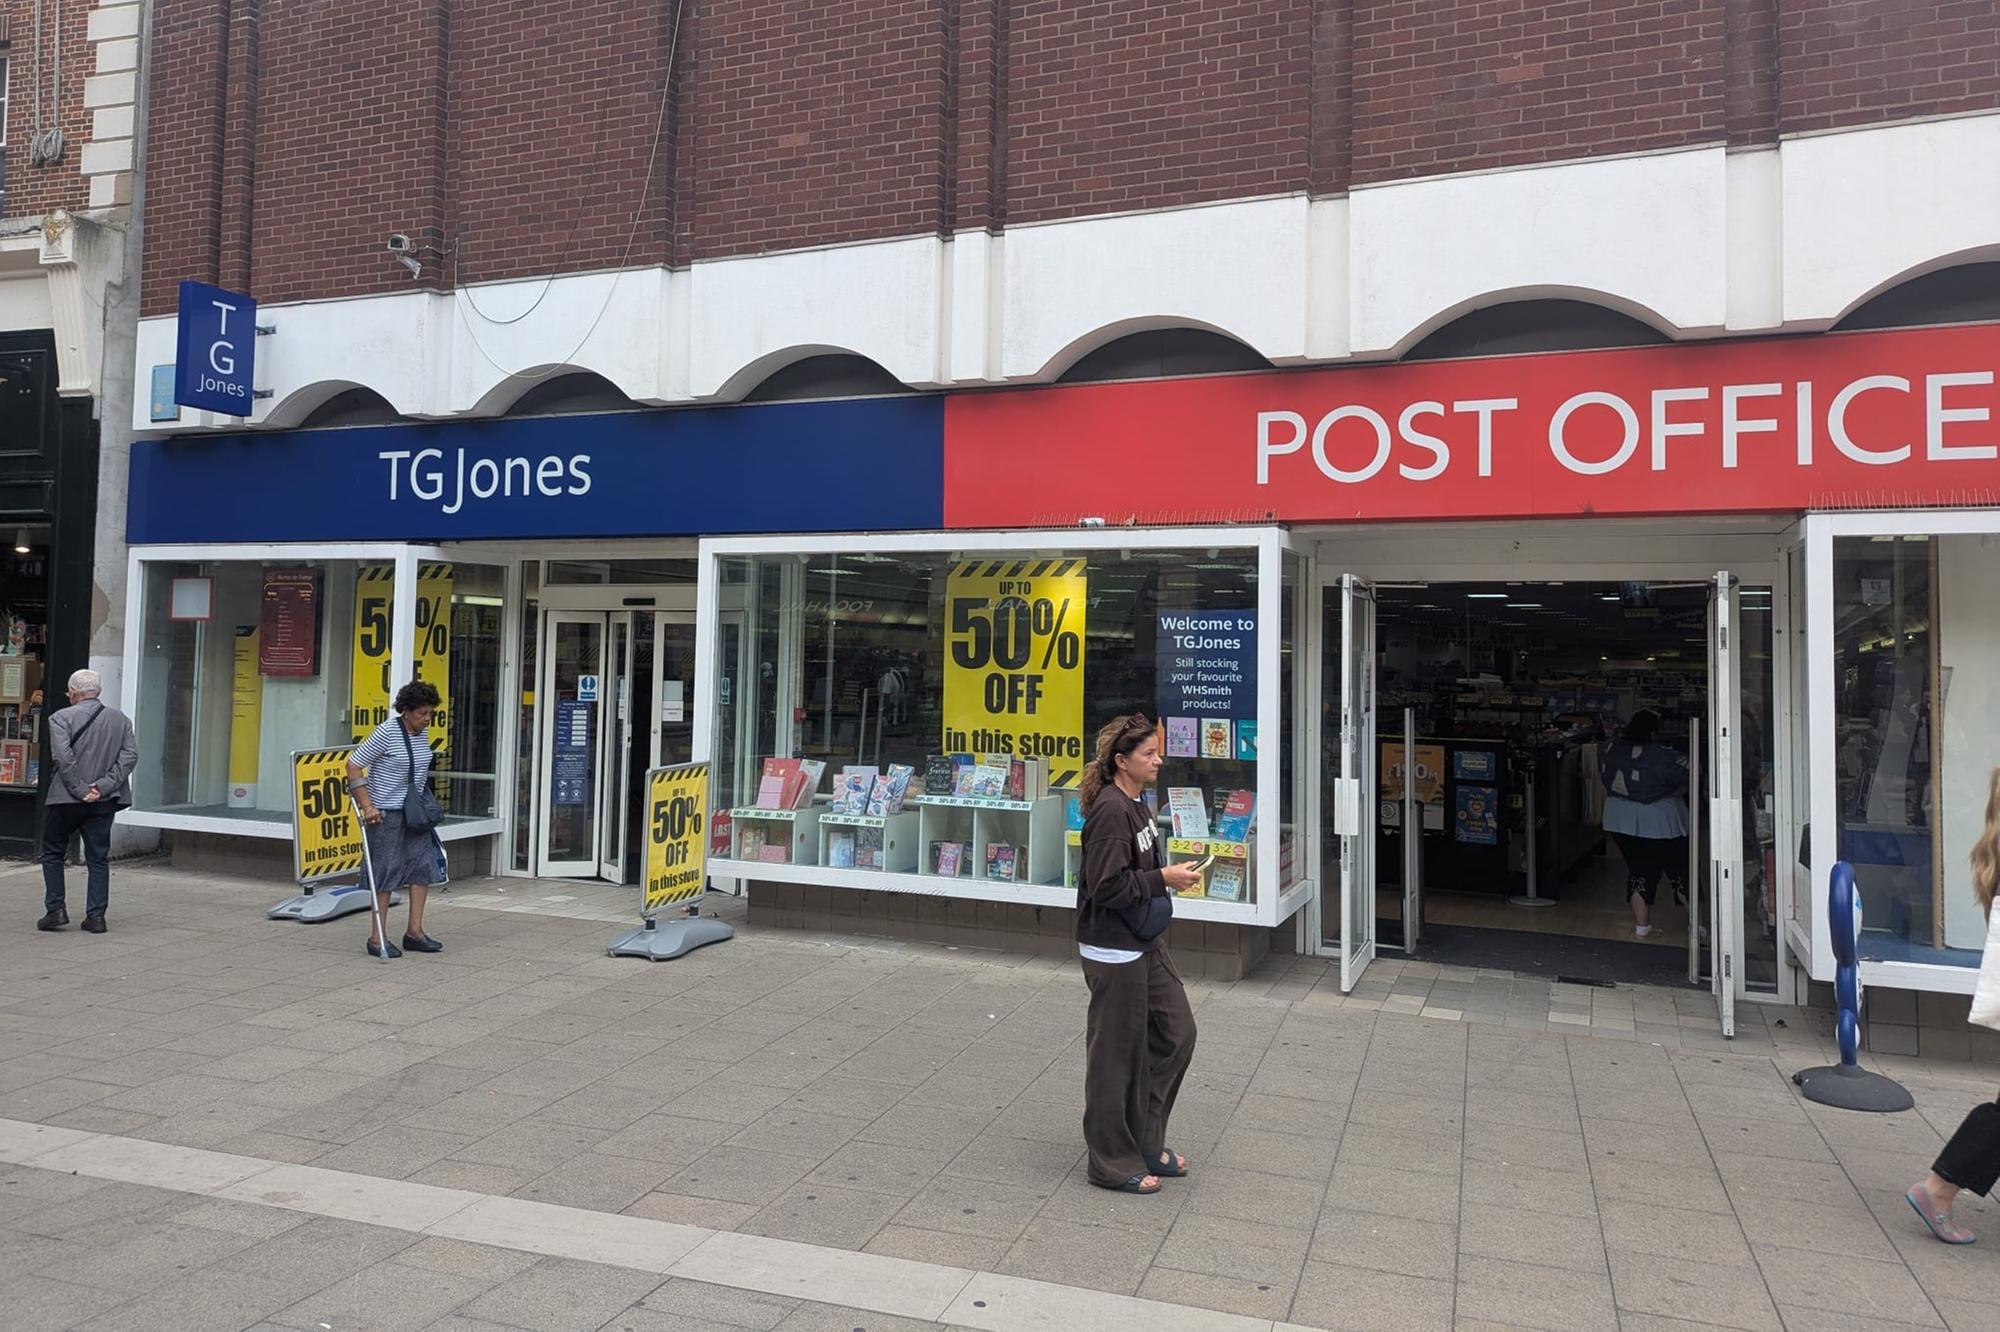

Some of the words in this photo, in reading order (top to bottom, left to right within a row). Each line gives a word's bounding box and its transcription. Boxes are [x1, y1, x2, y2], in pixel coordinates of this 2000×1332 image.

[212, 300, 236, 335] T
[210, 341, 234, 375] G
[196, 372, 245, 398] Jones
[1256, 398, 1518, 485] POST
[1548, 371, 1998, 476] OFFICE
[379, 448, 592, 514] TGJones
[999, 581, 1014, 595] UP
[1016, 581, 1032, 594] TO
[360, 596, 447, 657] 5%
[952, 598, 1079, 670] 50%
[1161, 617, 1233, 631] Welcome
[1237, 618, 1254, 631] to
[1173, 635, 1241, 650] TGJones
[1175, 658, 1194, 669] Still
[1197, 658, 1239, 671] stocking
[1171, 672, 1194, 684] your
[1197, 671, 1242, 682] favourite
[985, 673, 1043, 715] OFF
[1182, 685, 1232, 696] WHSmith
[355, 705, 369, 726] in
[1182, 699, 1231, 711] products!
[946, 727, 966, 752] in
[972, 728, 1013, 753] this
[1019, 732, 1081, 758] store
[672, 788, 680, 797] UP
[321, 816, 350, 840] OFF
[653, 794, 702, 844] 50%
[304, 849, 315, 863] in
[317, 846, 338, 860] this
[666, 840, 689, 867] OFF
[650, 878, 659, 893] in
[660, 874, 678, 890] this
[678, 868, 700, 885] store
